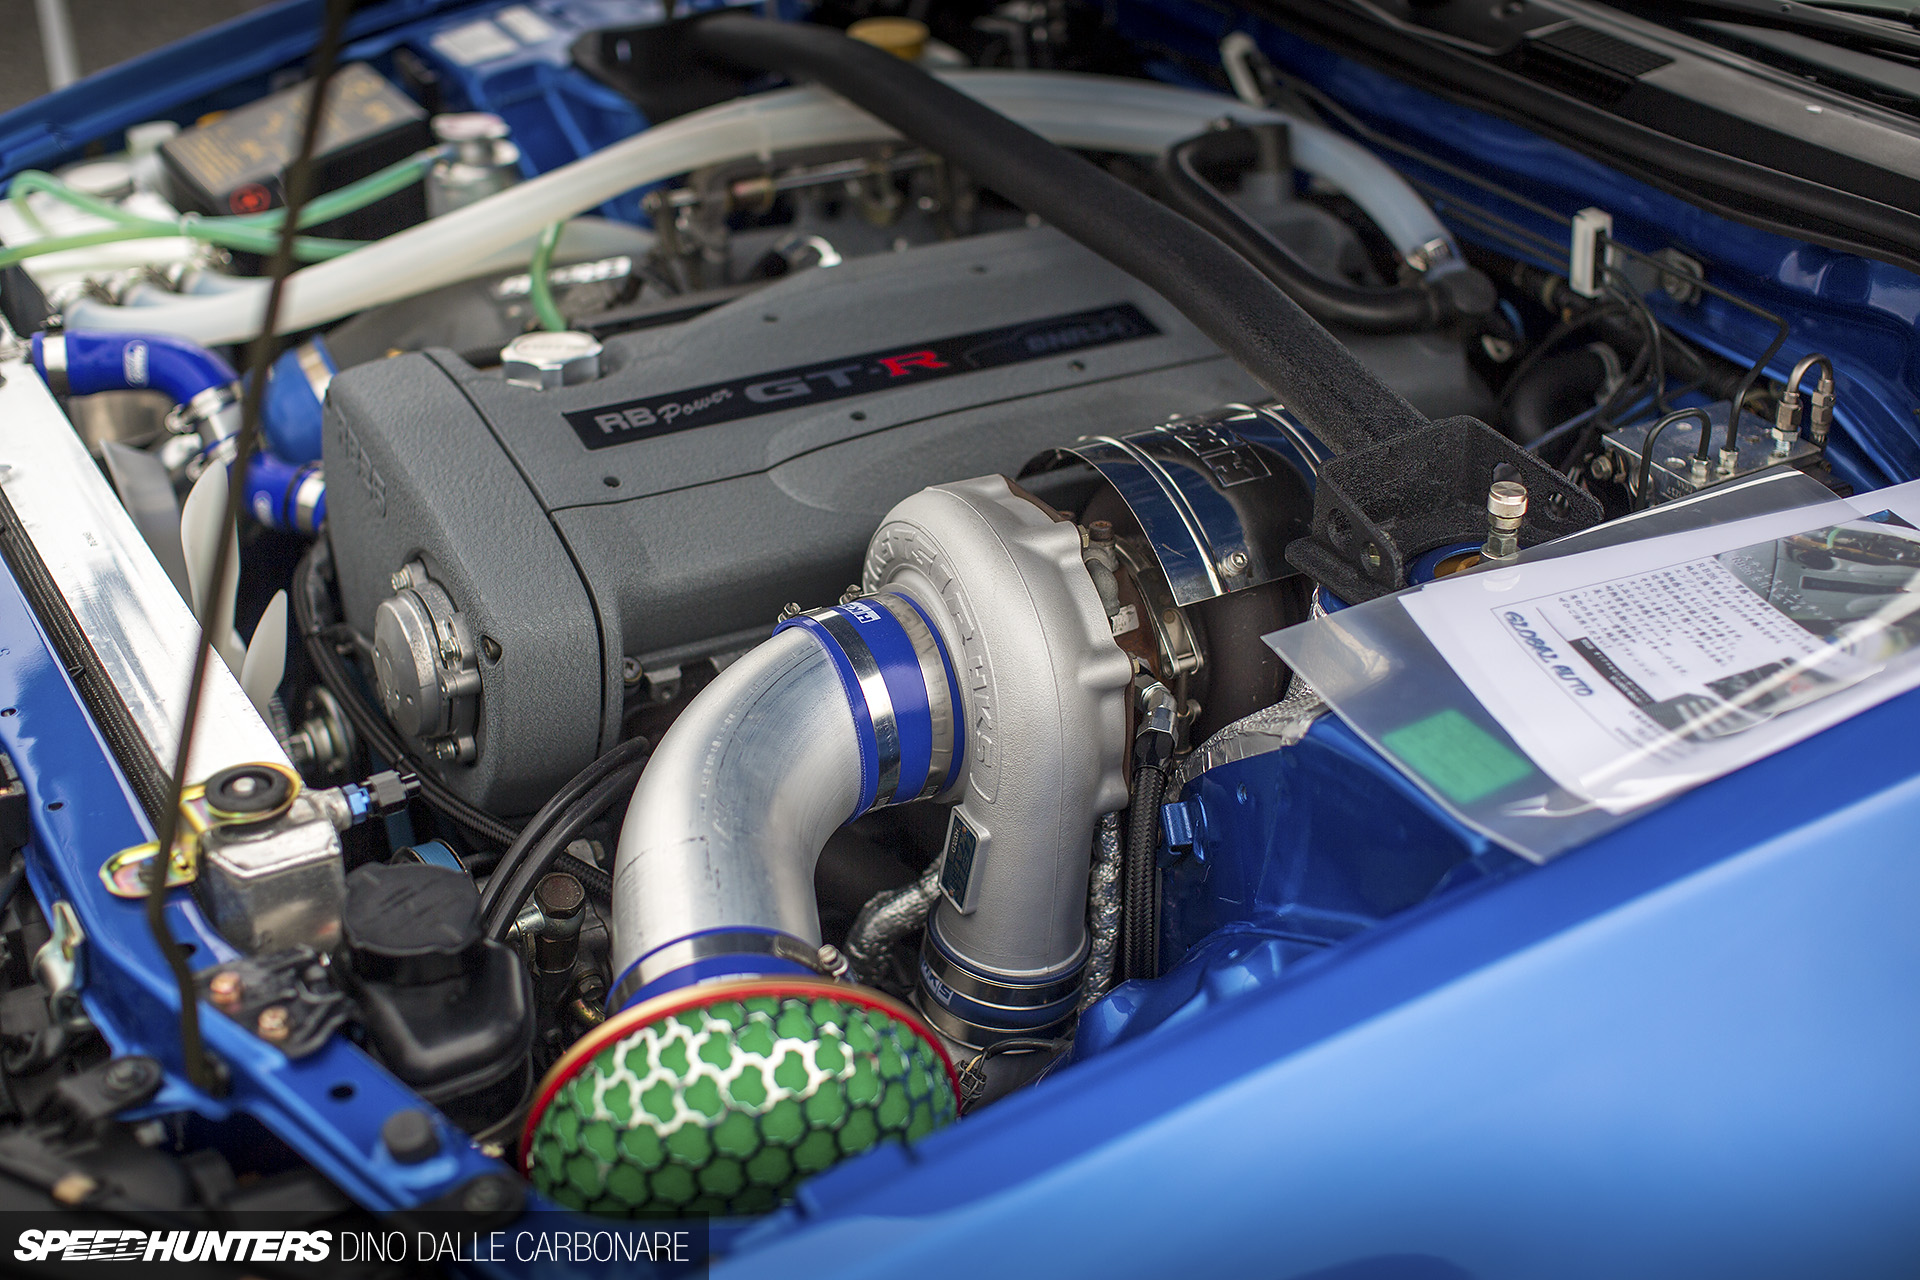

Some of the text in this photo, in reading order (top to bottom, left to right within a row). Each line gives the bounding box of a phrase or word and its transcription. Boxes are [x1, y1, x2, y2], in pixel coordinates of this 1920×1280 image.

[594, 406, 657, 434] RB
[657, 388, 733, 425] Power
[1504, 611, 1594, 696] GLOBAL AUTO
